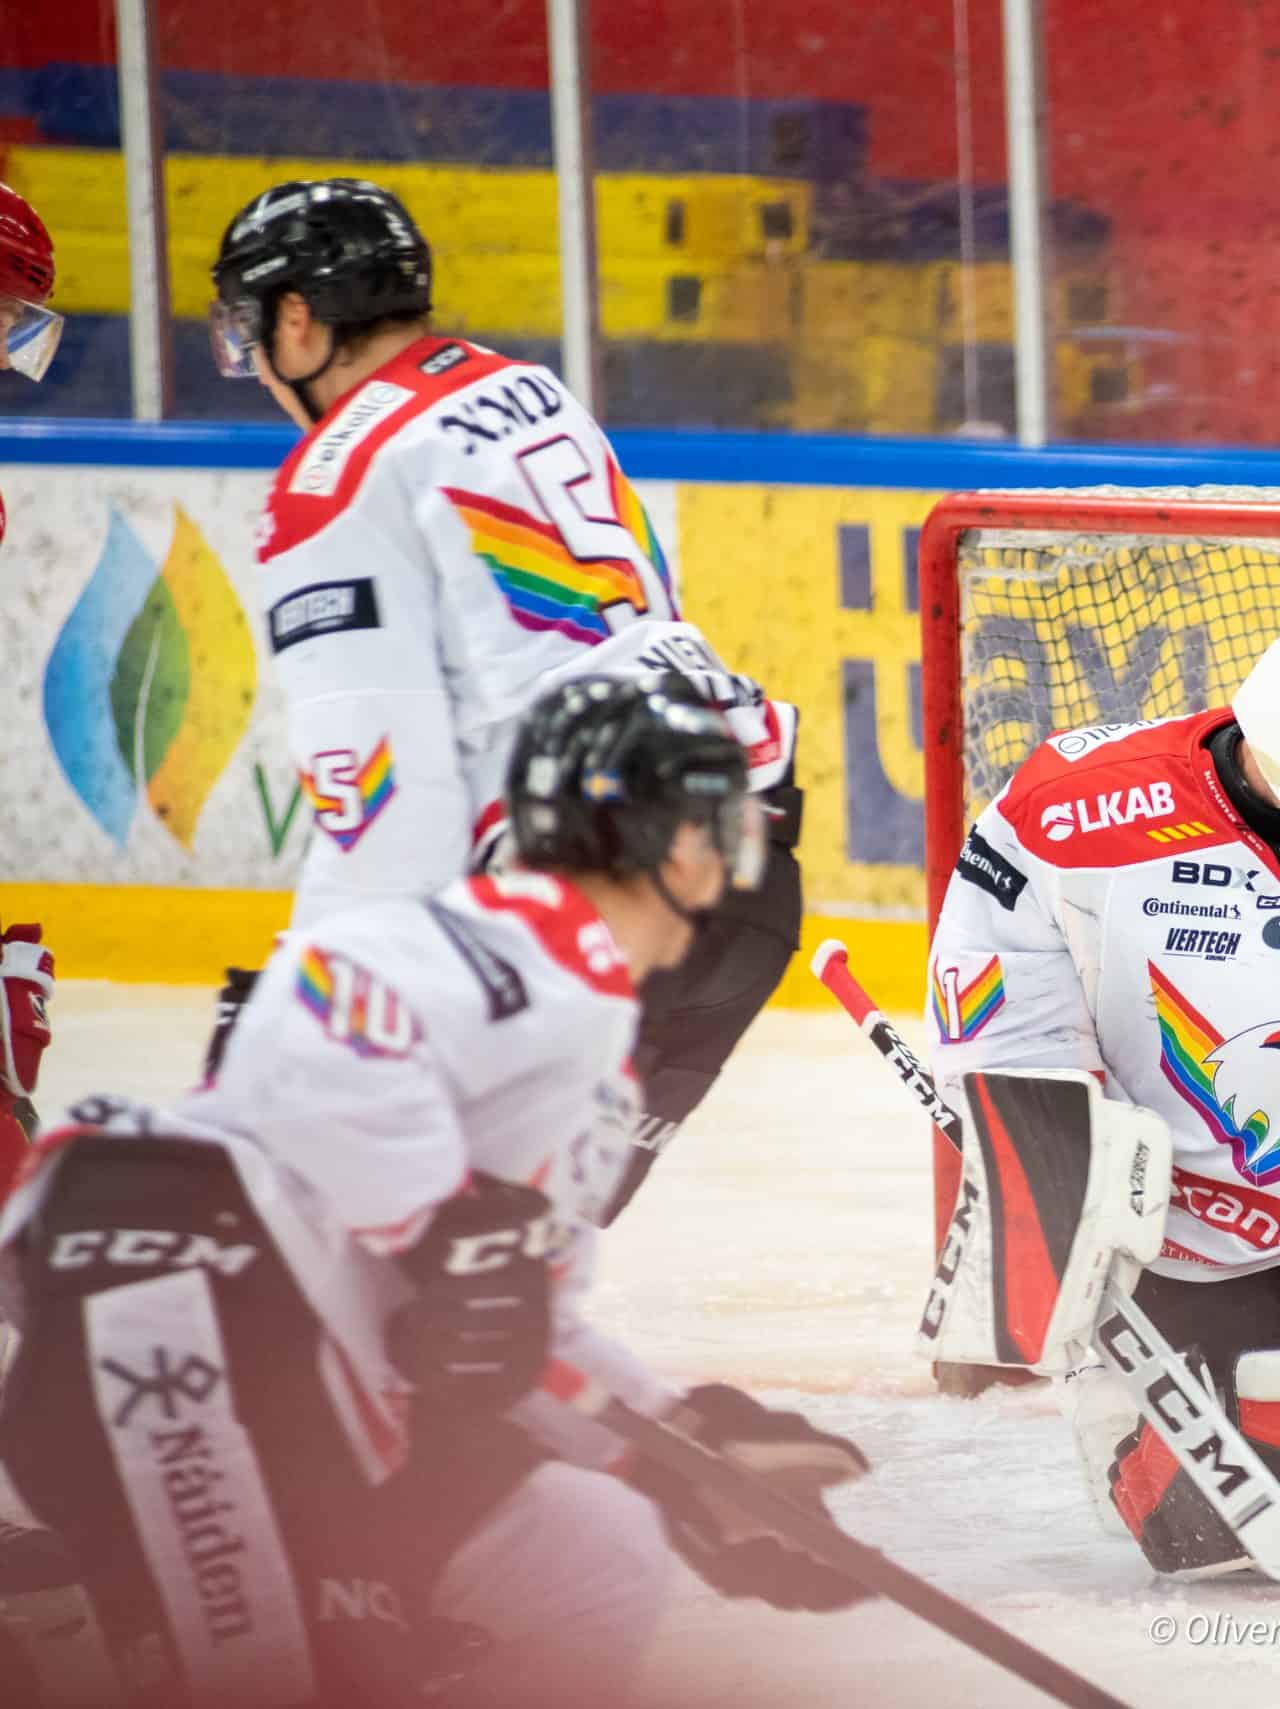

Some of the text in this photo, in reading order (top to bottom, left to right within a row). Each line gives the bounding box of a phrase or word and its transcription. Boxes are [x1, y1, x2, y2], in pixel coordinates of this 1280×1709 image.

[312, 749, 361, 834] 5
[1077, 781, 1176, 833] LKAB
[1171, 860, 1260, 892] BDX
[1142, 897, 1228, 919] Continental
[1165, 927, 1242, 956] VERTECH
[49, 1229, 257, 1276] CCM
[919, 1178, 980, 1341] CCM
[1098, 1311, 1252, 1498] CCM
